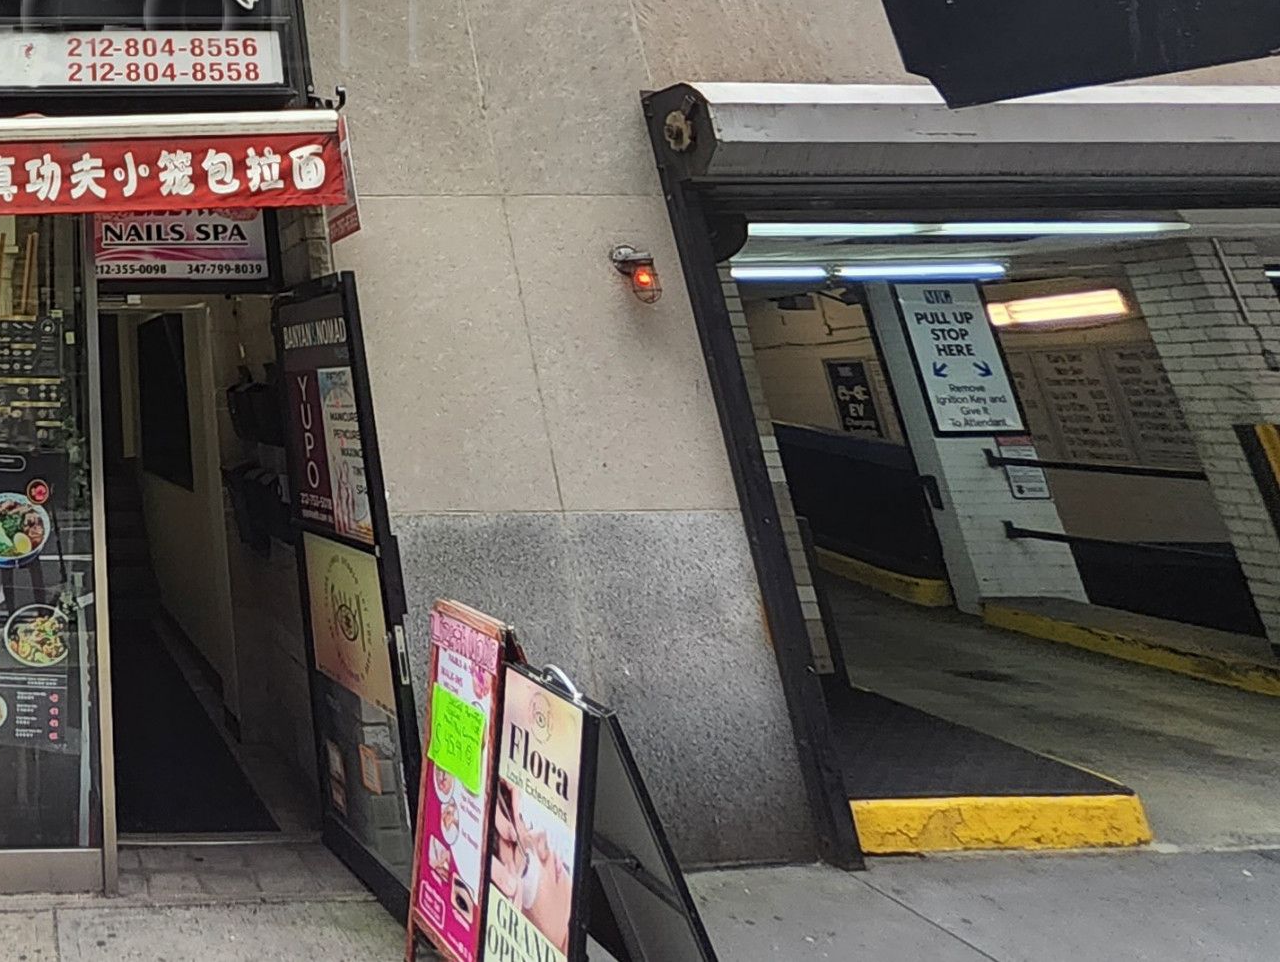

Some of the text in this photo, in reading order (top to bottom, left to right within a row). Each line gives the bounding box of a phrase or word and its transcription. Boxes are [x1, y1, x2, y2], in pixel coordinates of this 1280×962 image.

[66, 37, 258, 58] 212-804-8556
[67, 62, 260, 83] 212-804-8558
[103, 223, 247, 242] NAILS SPA
[187, 264, 262, 275] 347-799-8039
[914, 311, 974, 325] PULL UP
[316, 317, 347, 347] NOMAD
[930, 328, 969, 341] STOP
[935, 344, 976, 357] HERE
[949, 384, 985, 393] Remove
[937, 395, 1007, 406] Ignition Key and
[849, 404, 865, 417] EV
[960, 407, 981, 416] Give
[297, 375, 320, 489] YUPO
[509, 721, 569, 801] Flora
